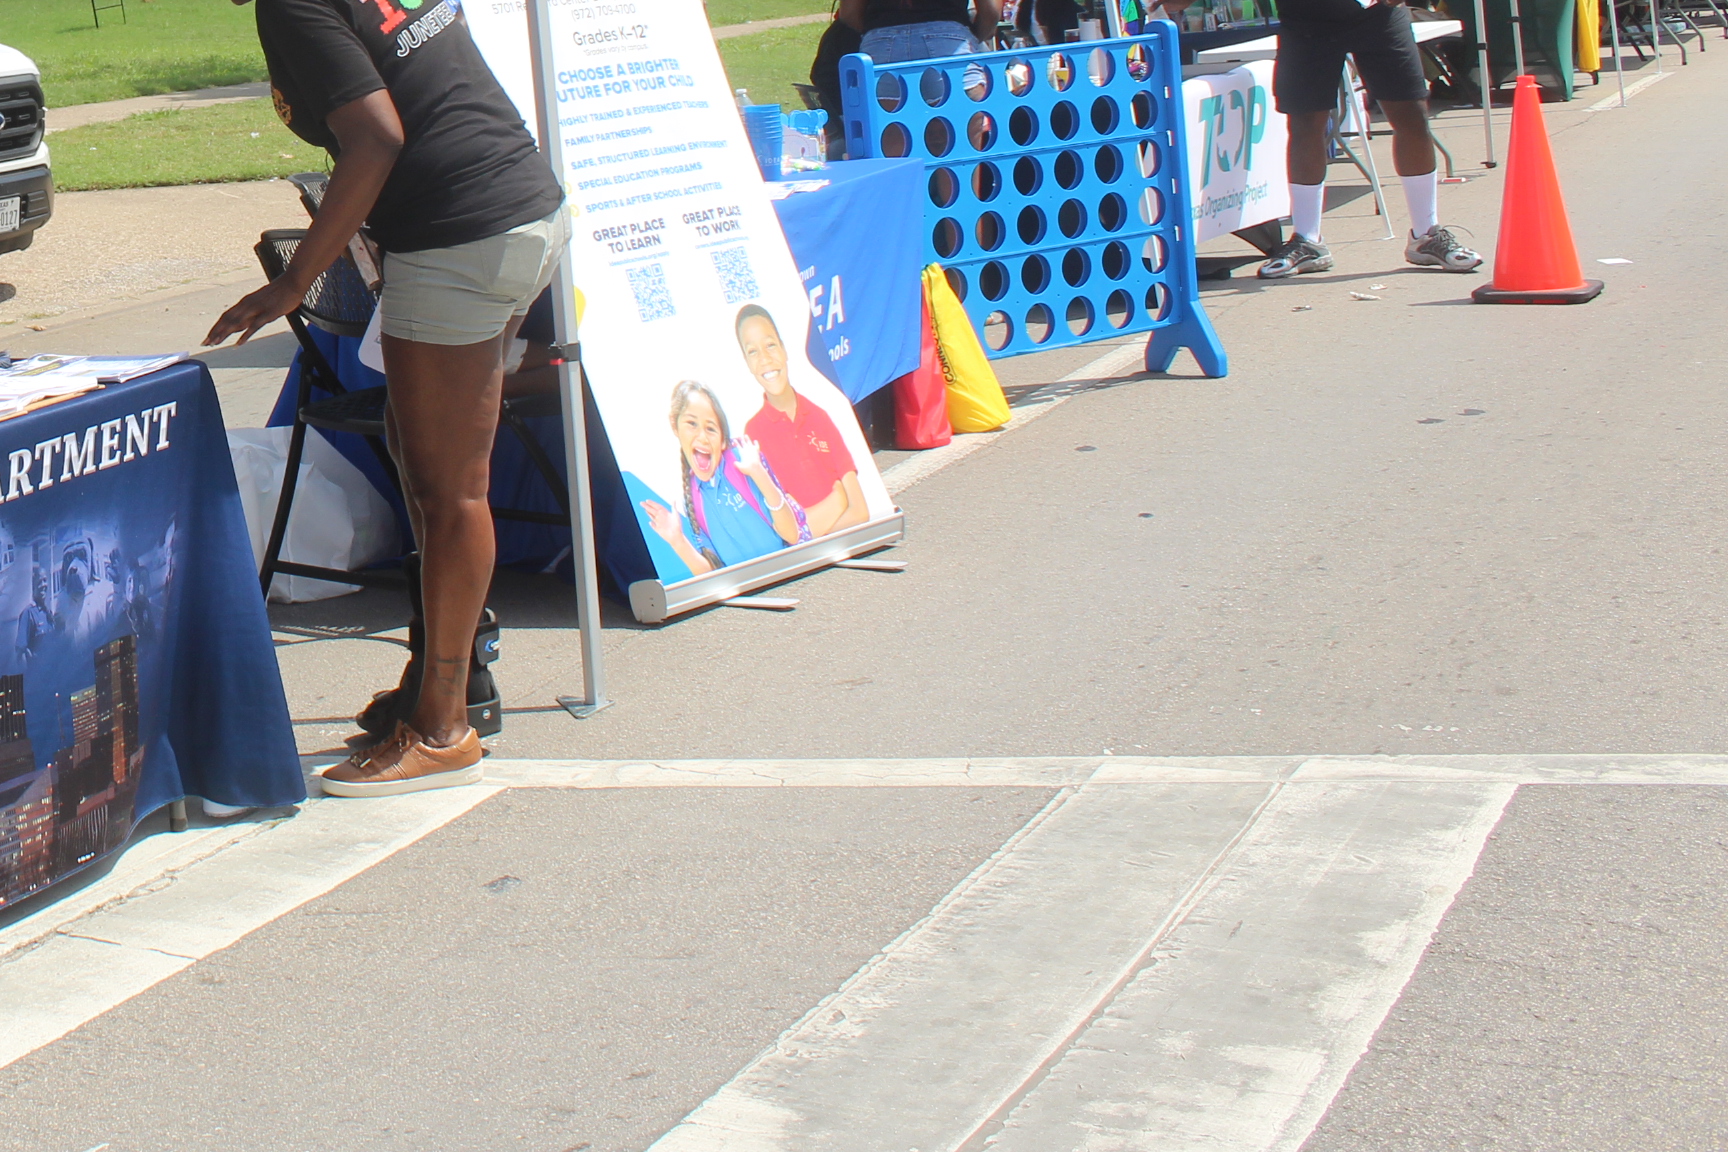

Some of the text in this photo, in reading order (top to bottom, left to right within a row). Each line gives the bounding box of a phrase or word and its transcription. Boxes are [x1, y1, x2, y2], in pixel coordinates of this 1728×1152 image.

[491, 3, 515, 15] 5701
[571, 3, 636, 22] (972) 709-4700
[397, 0, 459, 57] JUNETEE
[572, 29, 618, 47] Grades
[558, 58, 680, 85] CHOOSE A BRIGHTER
[556, 75, 694, 103] UTURE FOR YOUR CHILD
[559, 100, 709, 127] HIGHLY TRAINED & EXPERIENCED TEACHERS
[565, 126, 653, 147] FAMILY PARTNERSHIPS
[1198, 85, 1267, 192] TOP
[571, 140, 728, 170] SAFE, STRUCTURED LEARNING ENVIRONMENT
[578, 162, 703, 190] SPECIAL EDUCATION PROGRAMS
[586, 201, 619, 213] SPORTS
[626, 193, 653, 206] AFTER
[653, 188, 683, 201] SCHOOL
[683, 182, 723, 195] ACTIVITIES
[1205, 188, 1244, 219] Organizing
[1245, 181, 1268, 209] Project
[682, 206, 742, 224] GREAT PLACE
[696, 220, 741, 237] TO WORK
[592, 218, 666, 242] GREAT PLACE
[608, 234, 662, 254] TO LEARN
[809, 274, 846, 332] EA
